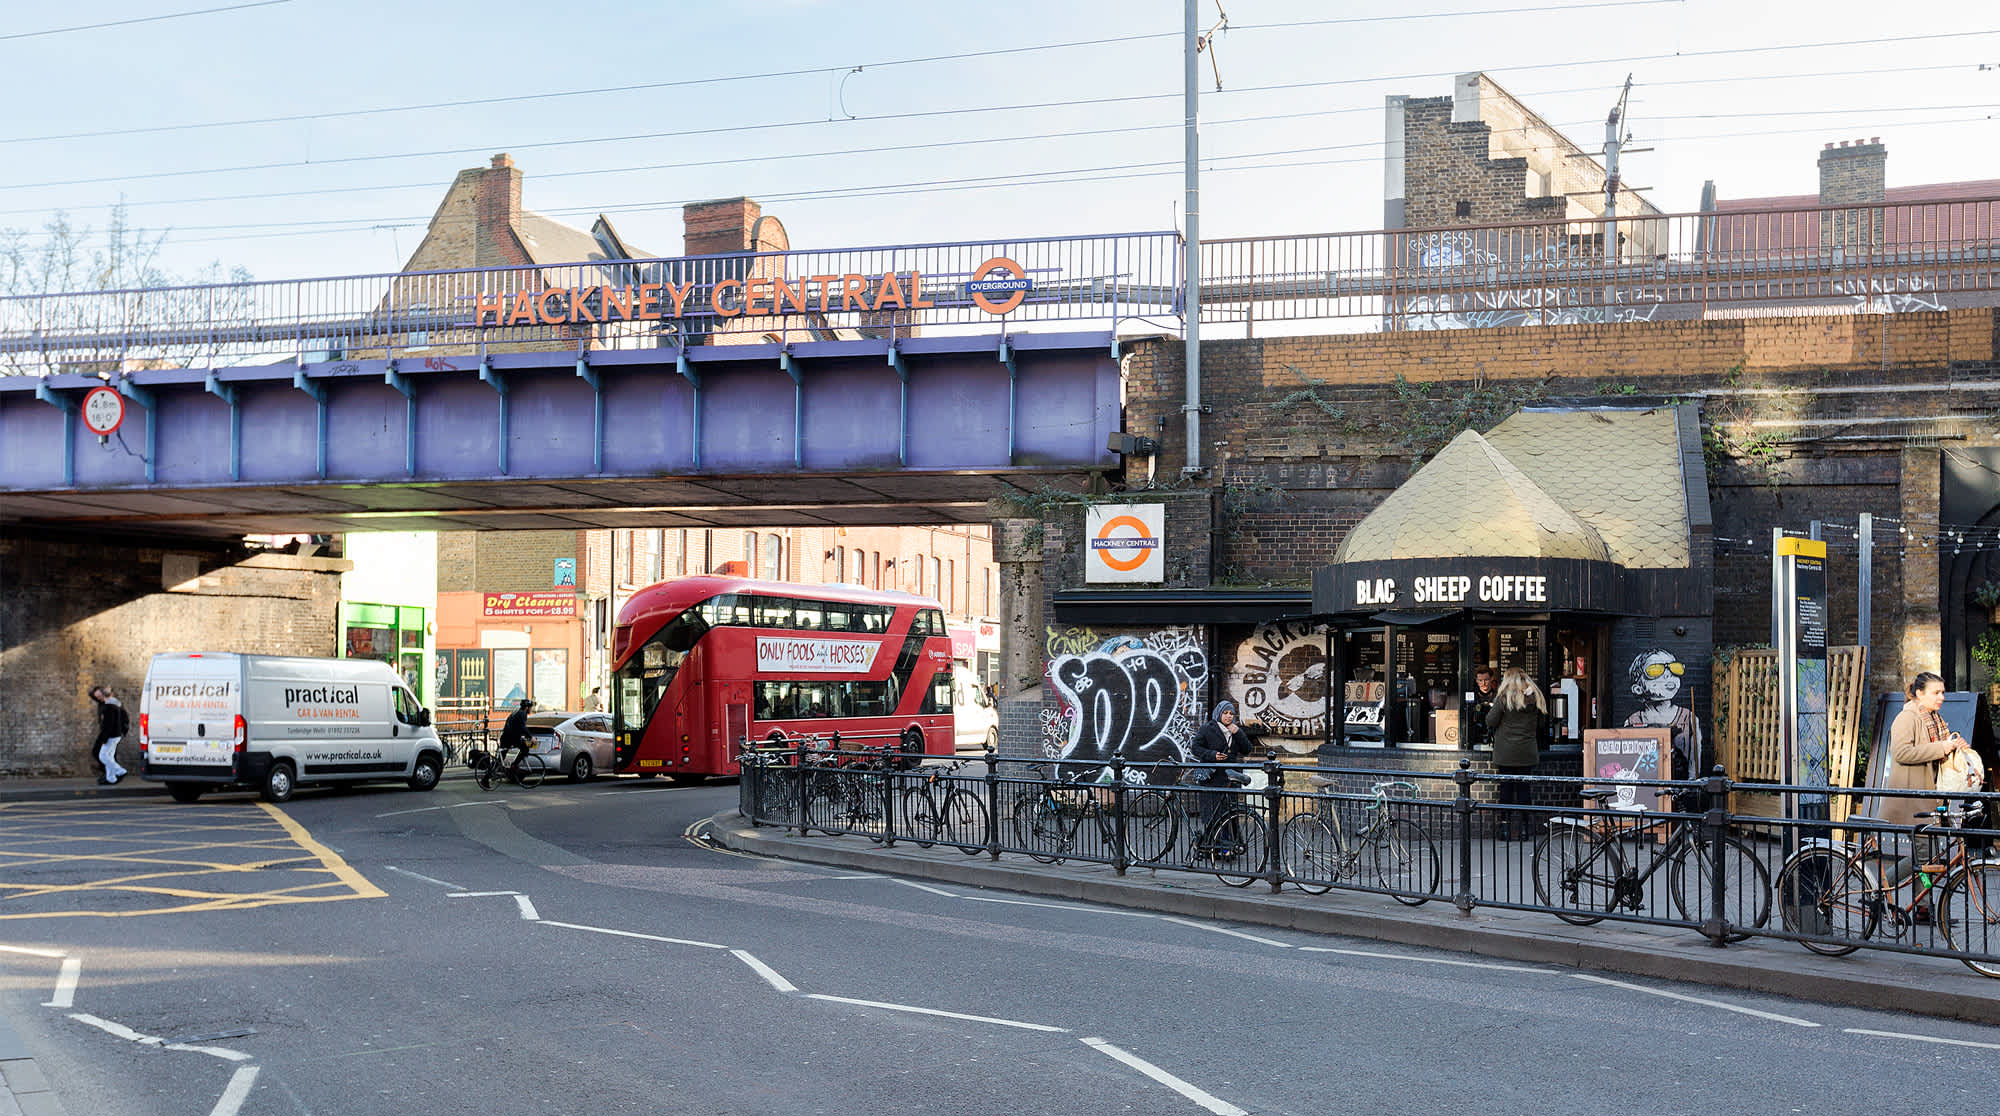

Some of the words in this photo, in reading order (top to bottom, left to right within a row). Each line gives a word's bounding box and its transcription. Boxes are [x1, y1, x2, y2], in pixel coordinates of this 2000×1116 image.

[970, 281, 1027, 291] OVERGROUND
[476, 280, 694, 326] HACKNEY
[711, 270, 934, 317] CENTRAL
[1094, 540, 1125, 548] HACKNEY
[1356, 578, 1395, 605] BLAC
[1414, 576, 1471, 602] SHEEP
[1479, 575, 1547, 602] COFFEE
[487, 597, 511, 608] Dry
[515, 597, 574, 607] Cleaners
[760, 642, 785, 660] ONLY
[787, 642, 815, 661] FOOLS
[830, 644, 865, 664] HORSES
[955, 643, 975, 657] SPA
[155, 682, 229, 700] practical
[285, 685, 359, 708] practical
[297, 708, 311, 718] CAR
[312, 708, 318, 718] &
[319, 708, 334, 718] VAN
[335, 708, 360, 718] RENTAL
[1599, 742, 1620, 753] ICED
[306, 749, 383, 762] www.practical.co.uk
